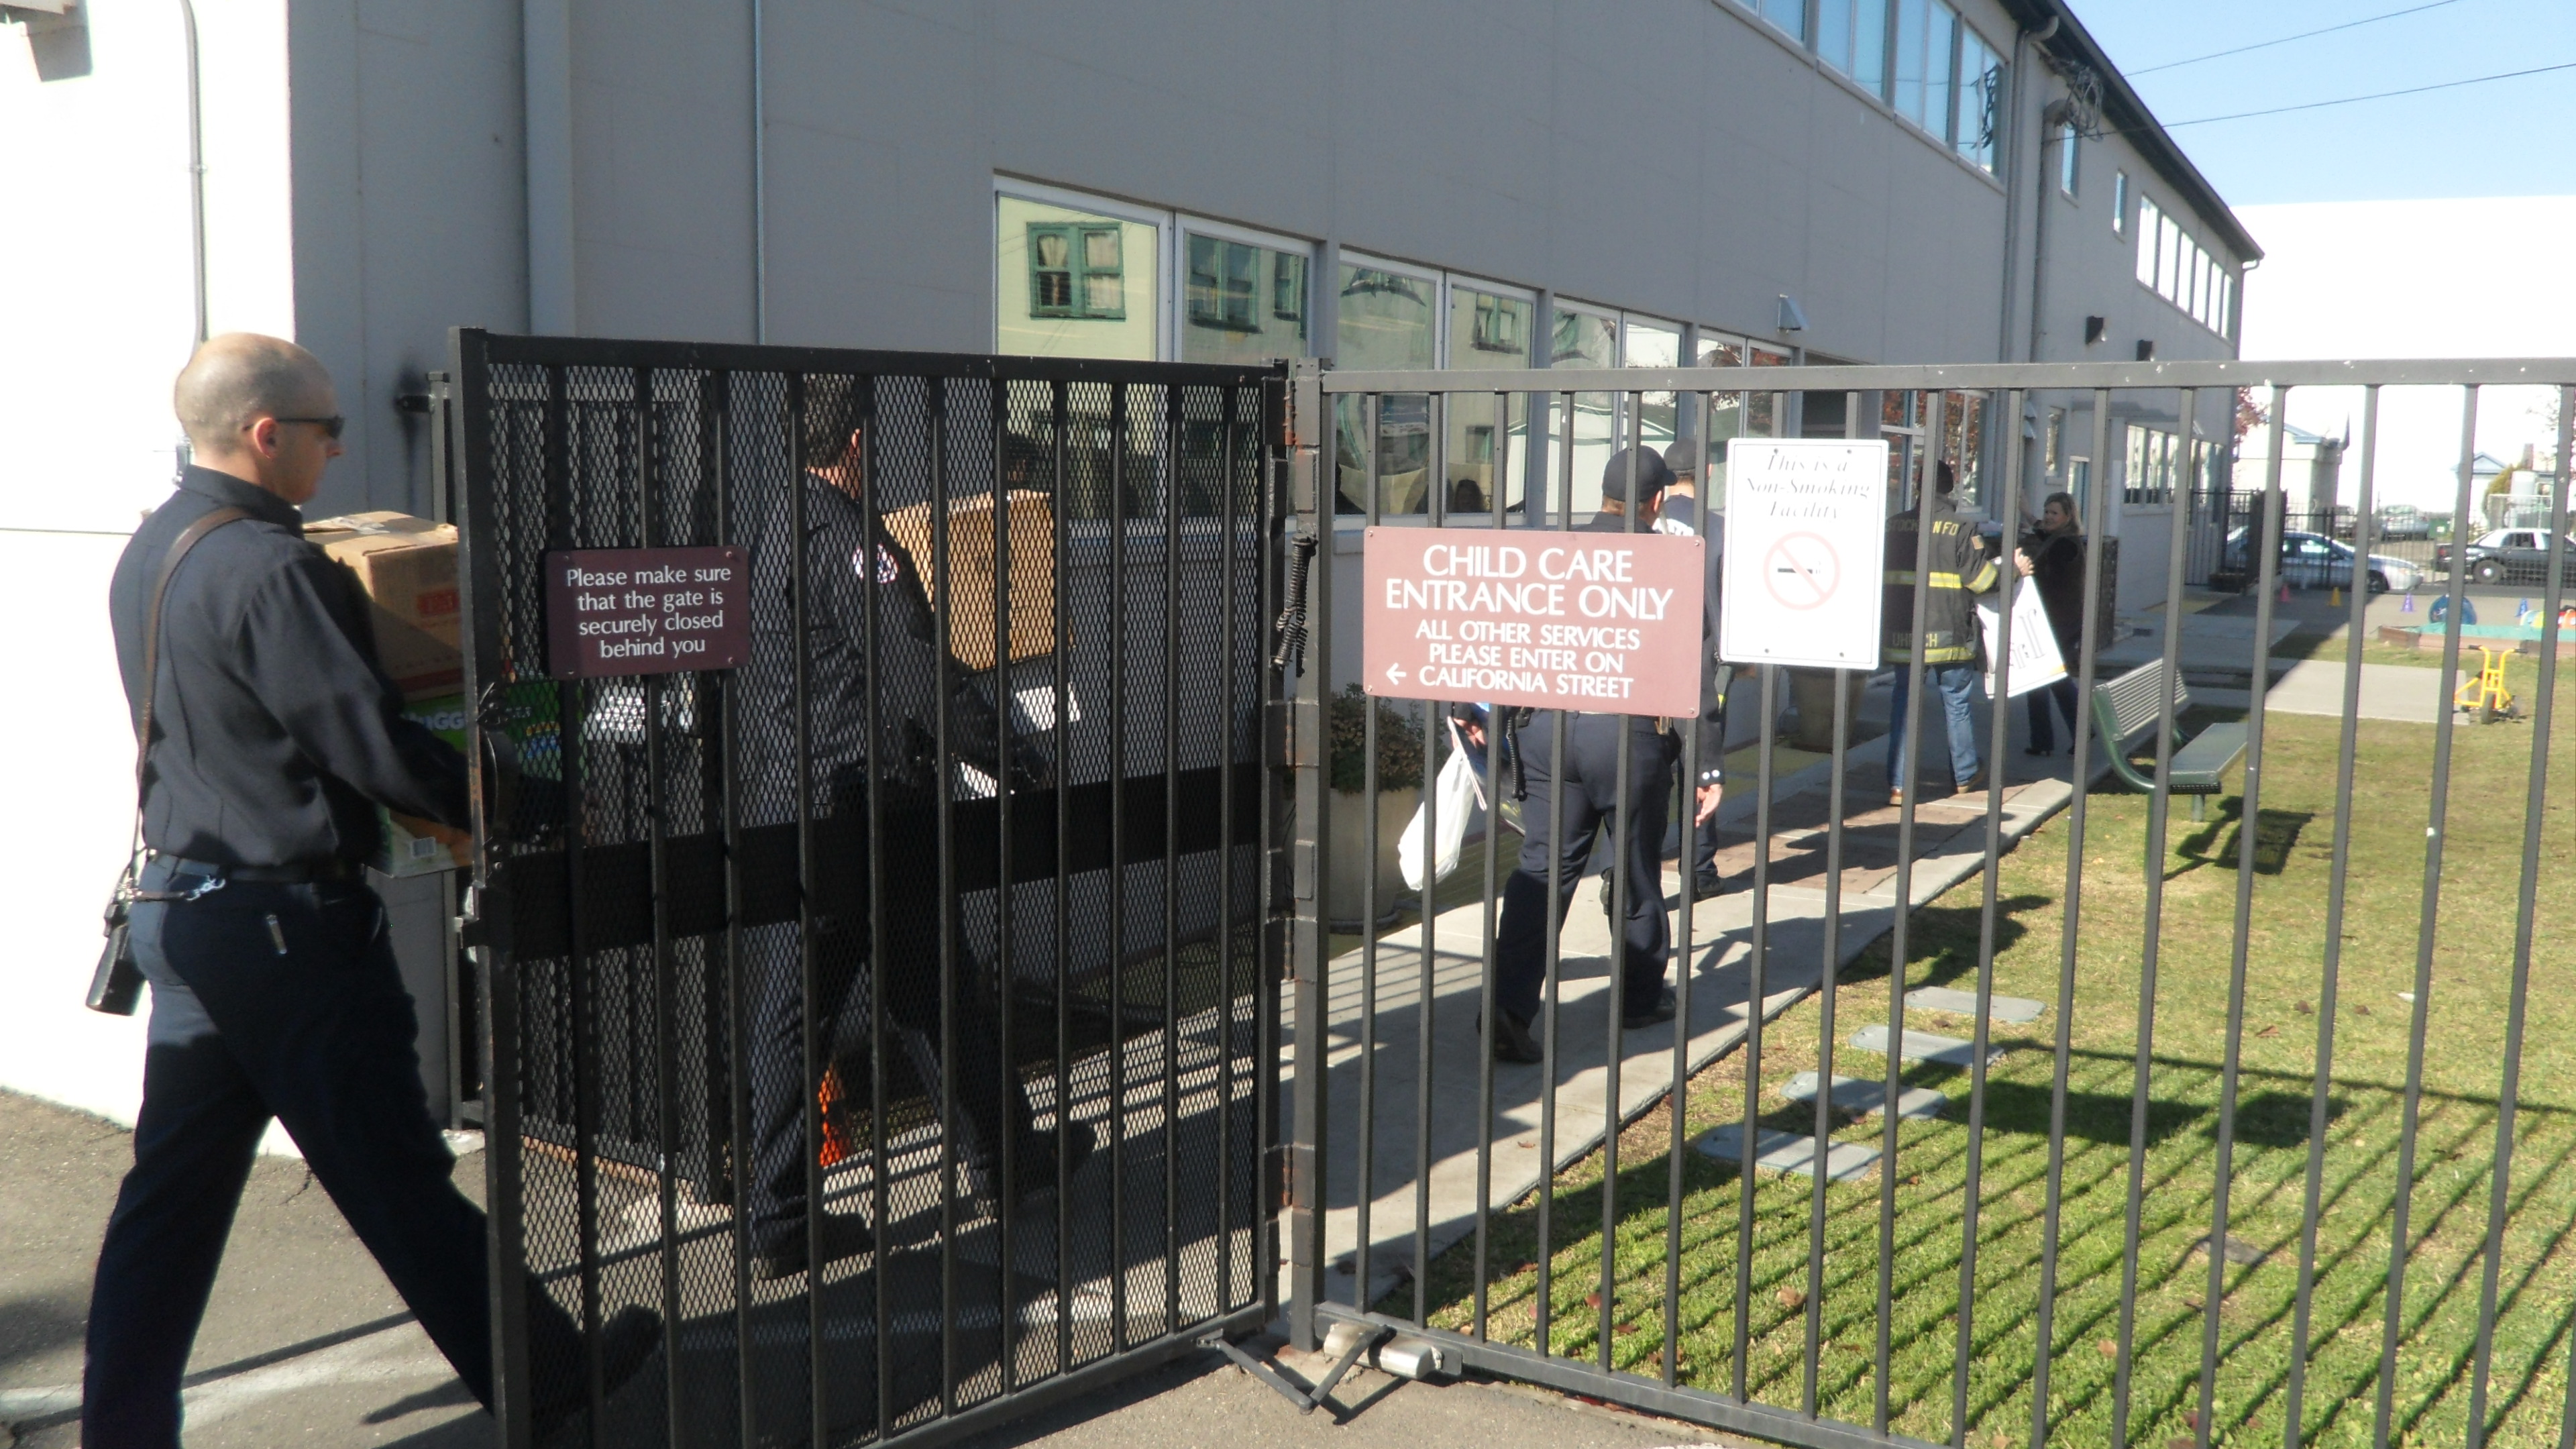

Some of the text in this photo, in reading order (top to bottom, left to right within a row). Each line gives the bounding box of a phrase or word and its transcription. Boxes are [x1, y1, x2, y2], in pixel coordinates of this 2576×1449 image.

[1767, 454, 1848, 472] This is a
[1746, 477, 1870, 499] Non-Smoking
[567, 565, 731, 587] Please make sure
[1423, 544, 1633, 583] CHILD CARE
[577, 587, 724, 614] that the gate is
[1386, 578, 1674, 621] ENTRANCE ONLY
[579, 608, 724, 637] securely closed
[1415, 619, 1641, 651] ALL OTHER SERVICES
[600, 636, 706, 659] behind you
[1429, 643, 1623, 674] PLEASE ENTER ON
[1419, 665, 1634, 698] CALIFORNIA STREET
